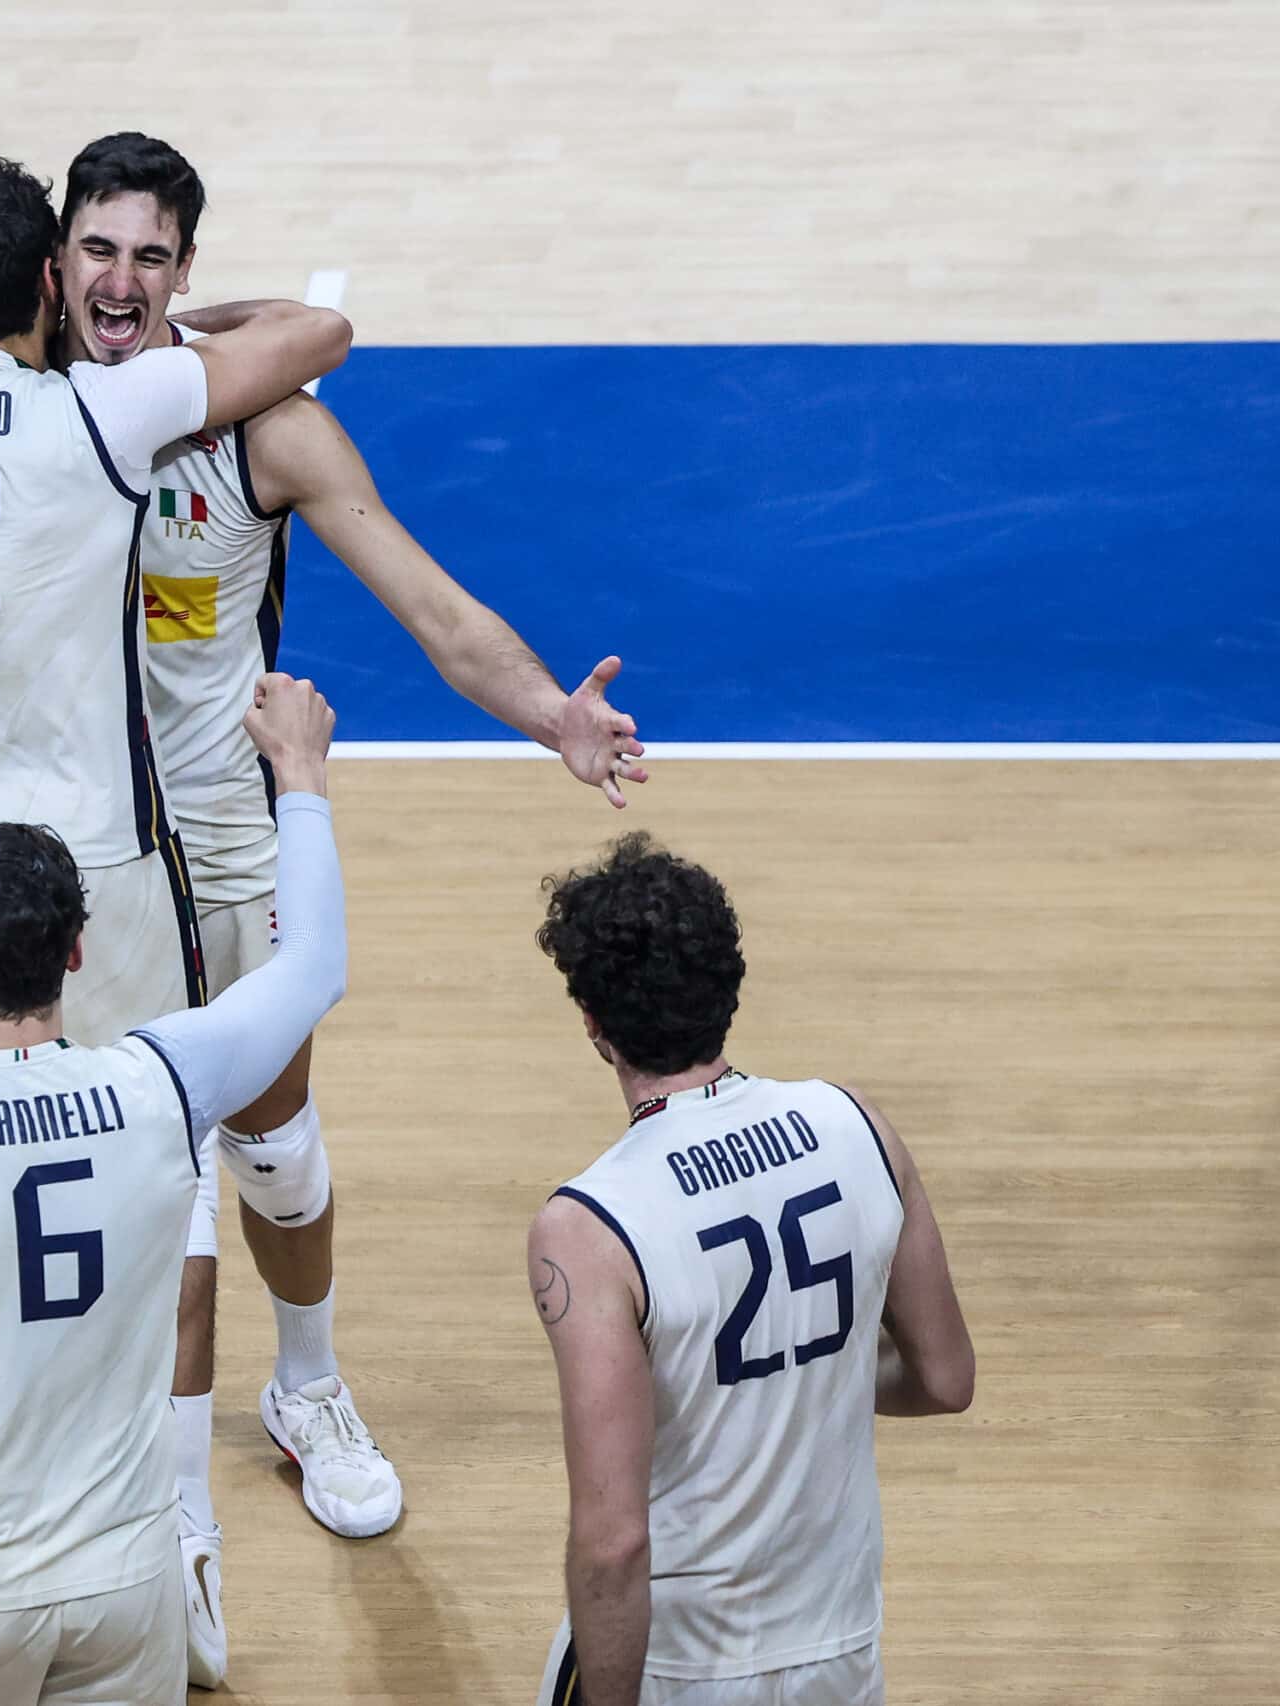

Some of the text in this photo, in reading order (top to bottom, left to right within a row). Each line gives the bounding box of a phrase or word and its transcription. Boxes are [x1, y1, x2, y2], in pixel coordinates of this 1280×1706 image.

[166, 519, 205, 541] ITA
[666, 1110, 819, 1197] GARGIULO
[12, 1157, 104, 1324] 6
[696, 1180, 854, 1386] 25
